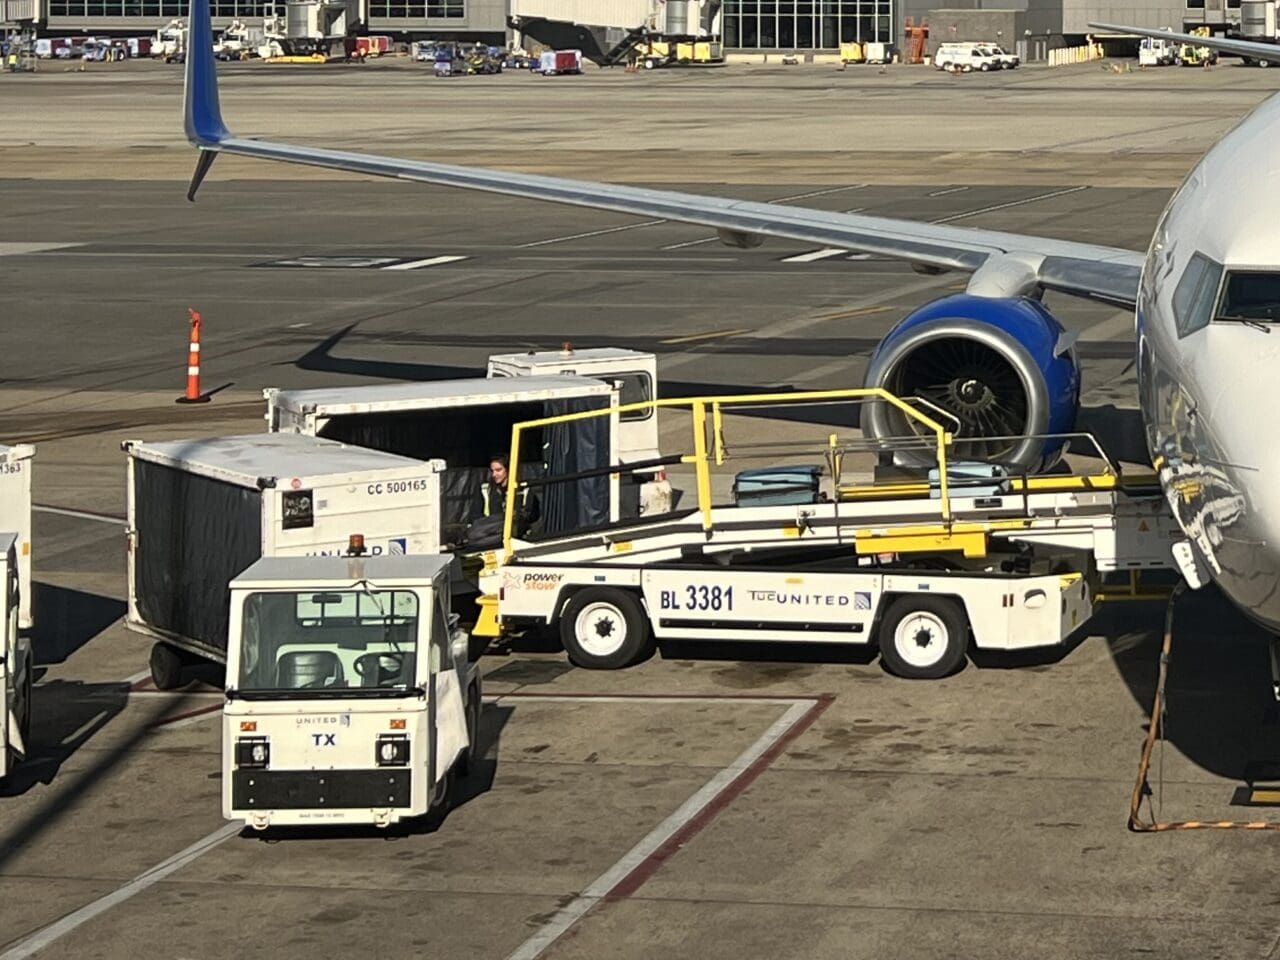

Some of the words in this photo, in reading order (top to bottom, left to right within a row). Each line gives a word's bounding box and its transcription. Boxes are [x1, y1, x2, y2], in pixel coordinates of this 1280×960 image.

[367, 483, 383, 495] CC
[387, 480, 427, 494] 500165
[523, 572, 564, 583] power
[525, 581, 556, 590] stow
[661, 590, 680, 610] BL
[686, 585, 733, 611] 3381
[777, 593, 849, 606] UNITED
[312, 733, 335, 746] TX
